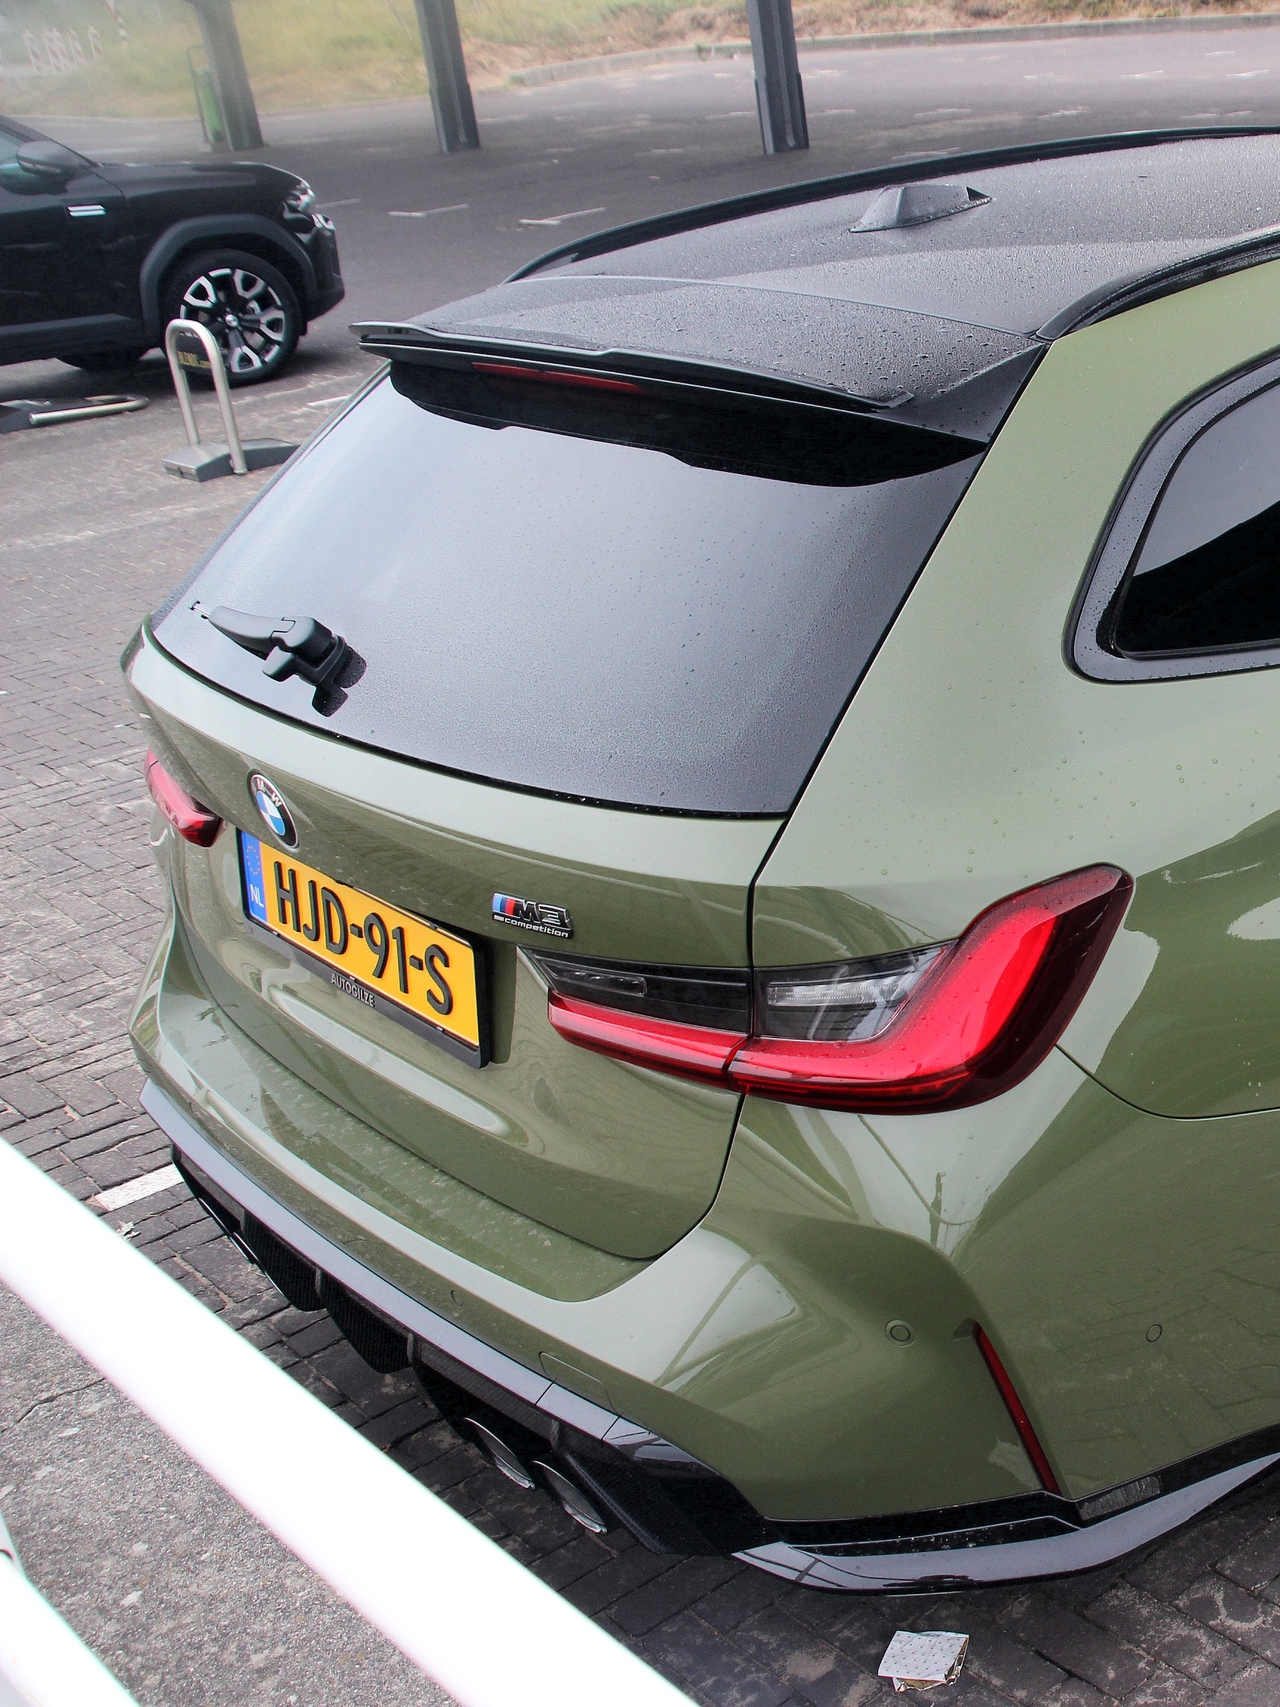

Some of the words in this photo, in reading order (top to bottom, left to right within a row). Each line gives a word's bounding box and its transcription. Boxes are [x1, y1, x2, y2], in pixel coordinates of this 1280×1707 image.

[252, 777, 283, 807] MW
[250, 884, 265, 909] NL
[504, 917, 569, 938] competition
[513, 899, 572, 930] M3
[273, 860, 453, 1016] HJD-91-S
[331, 972, 376, 1008] AUTOGILZE
